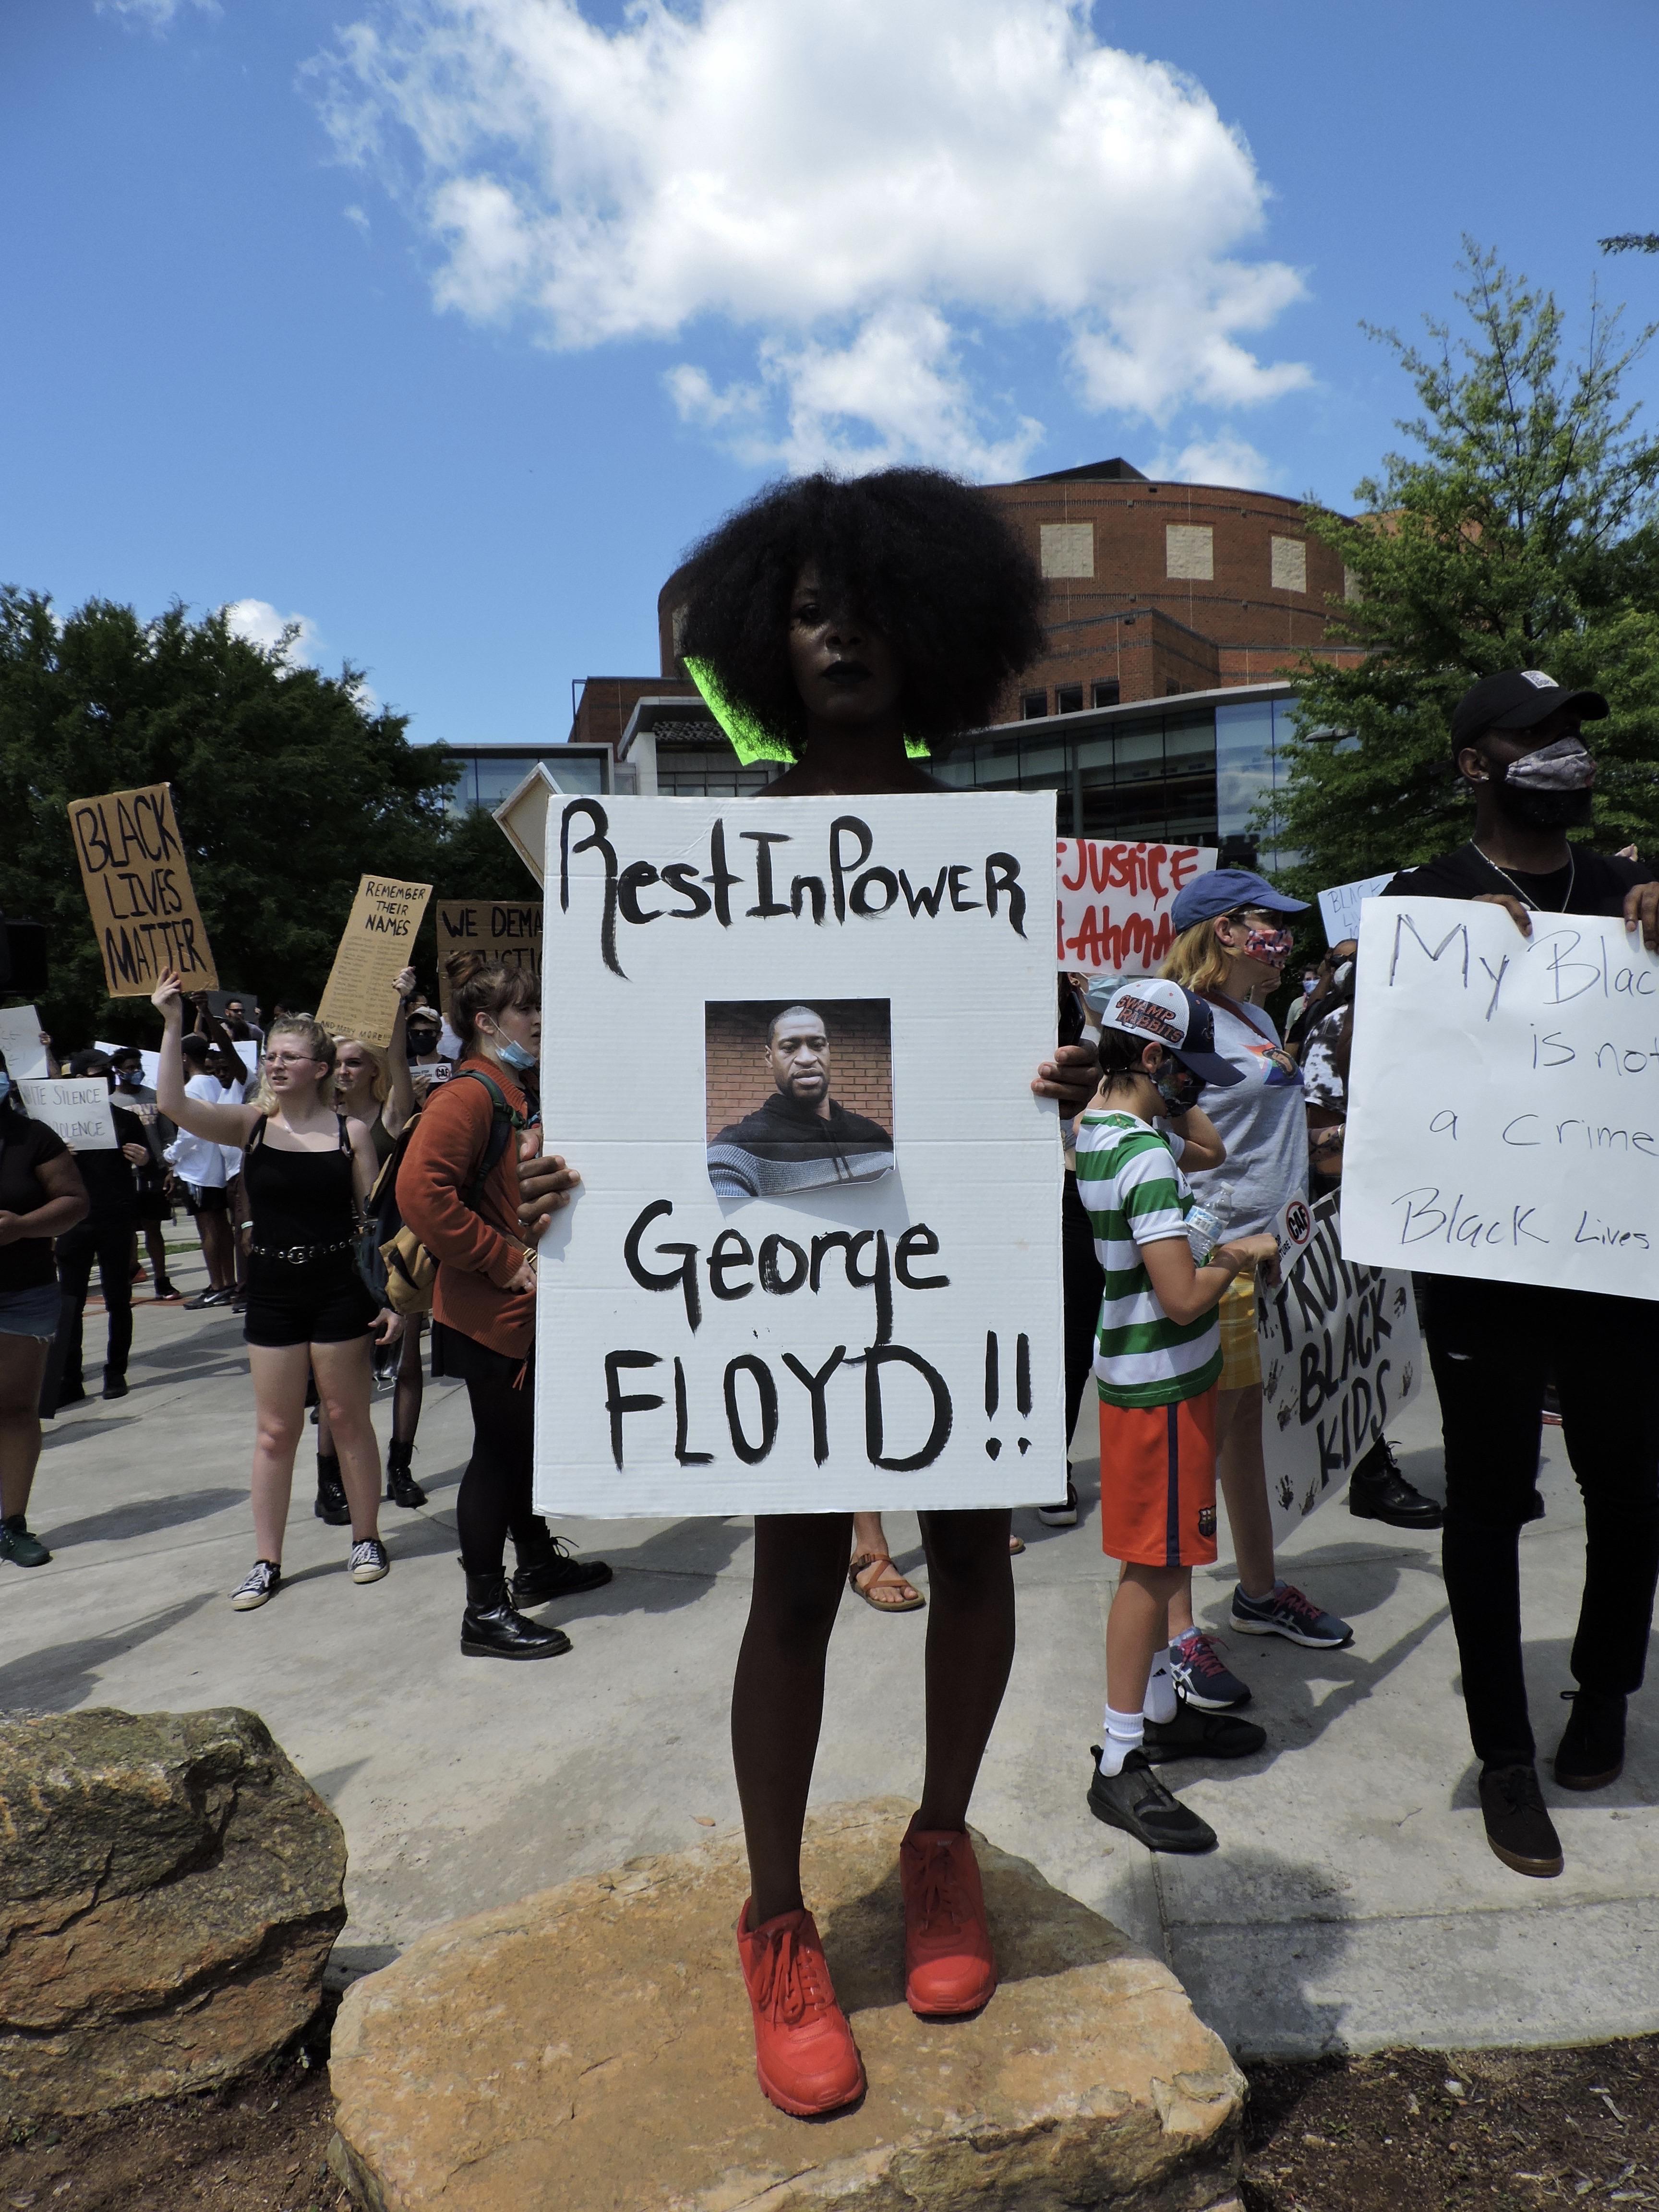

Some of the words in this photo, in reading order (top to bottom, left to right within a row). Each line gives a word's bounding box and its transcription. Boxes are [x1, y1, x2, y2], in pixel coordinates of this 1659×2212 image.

[75, 793, 181, 873] BLACK
[104, 868, 182, 919] LIVES
[365, 880, 426, 900] REMEMBER
[376, 900, 409, 916] THEIR
[560, 798, 745, 982] Rest
[365, 914, 411, 937] NAMES
[442, 908, 479, 938] WE
[491, 906, 543, 938] DEMA
[105, 917, 208, 990] MATTER
[1389, 913, 1510, 1022] My
[321, 1020, 336, 1029] AND
[1115, 1009, 1185, 1043] RABBITS
[1116, 994, 1177, 1021] SWAMP
[1430, 1110, 1458, 1141] a
[623, 1198, 951, 1369] George
[1299, 1278, 1392, 1426] BLACK
[605, 1344, 953, 1473] FLOYD
[1316, 1358, 1391, 1491] KIDS
